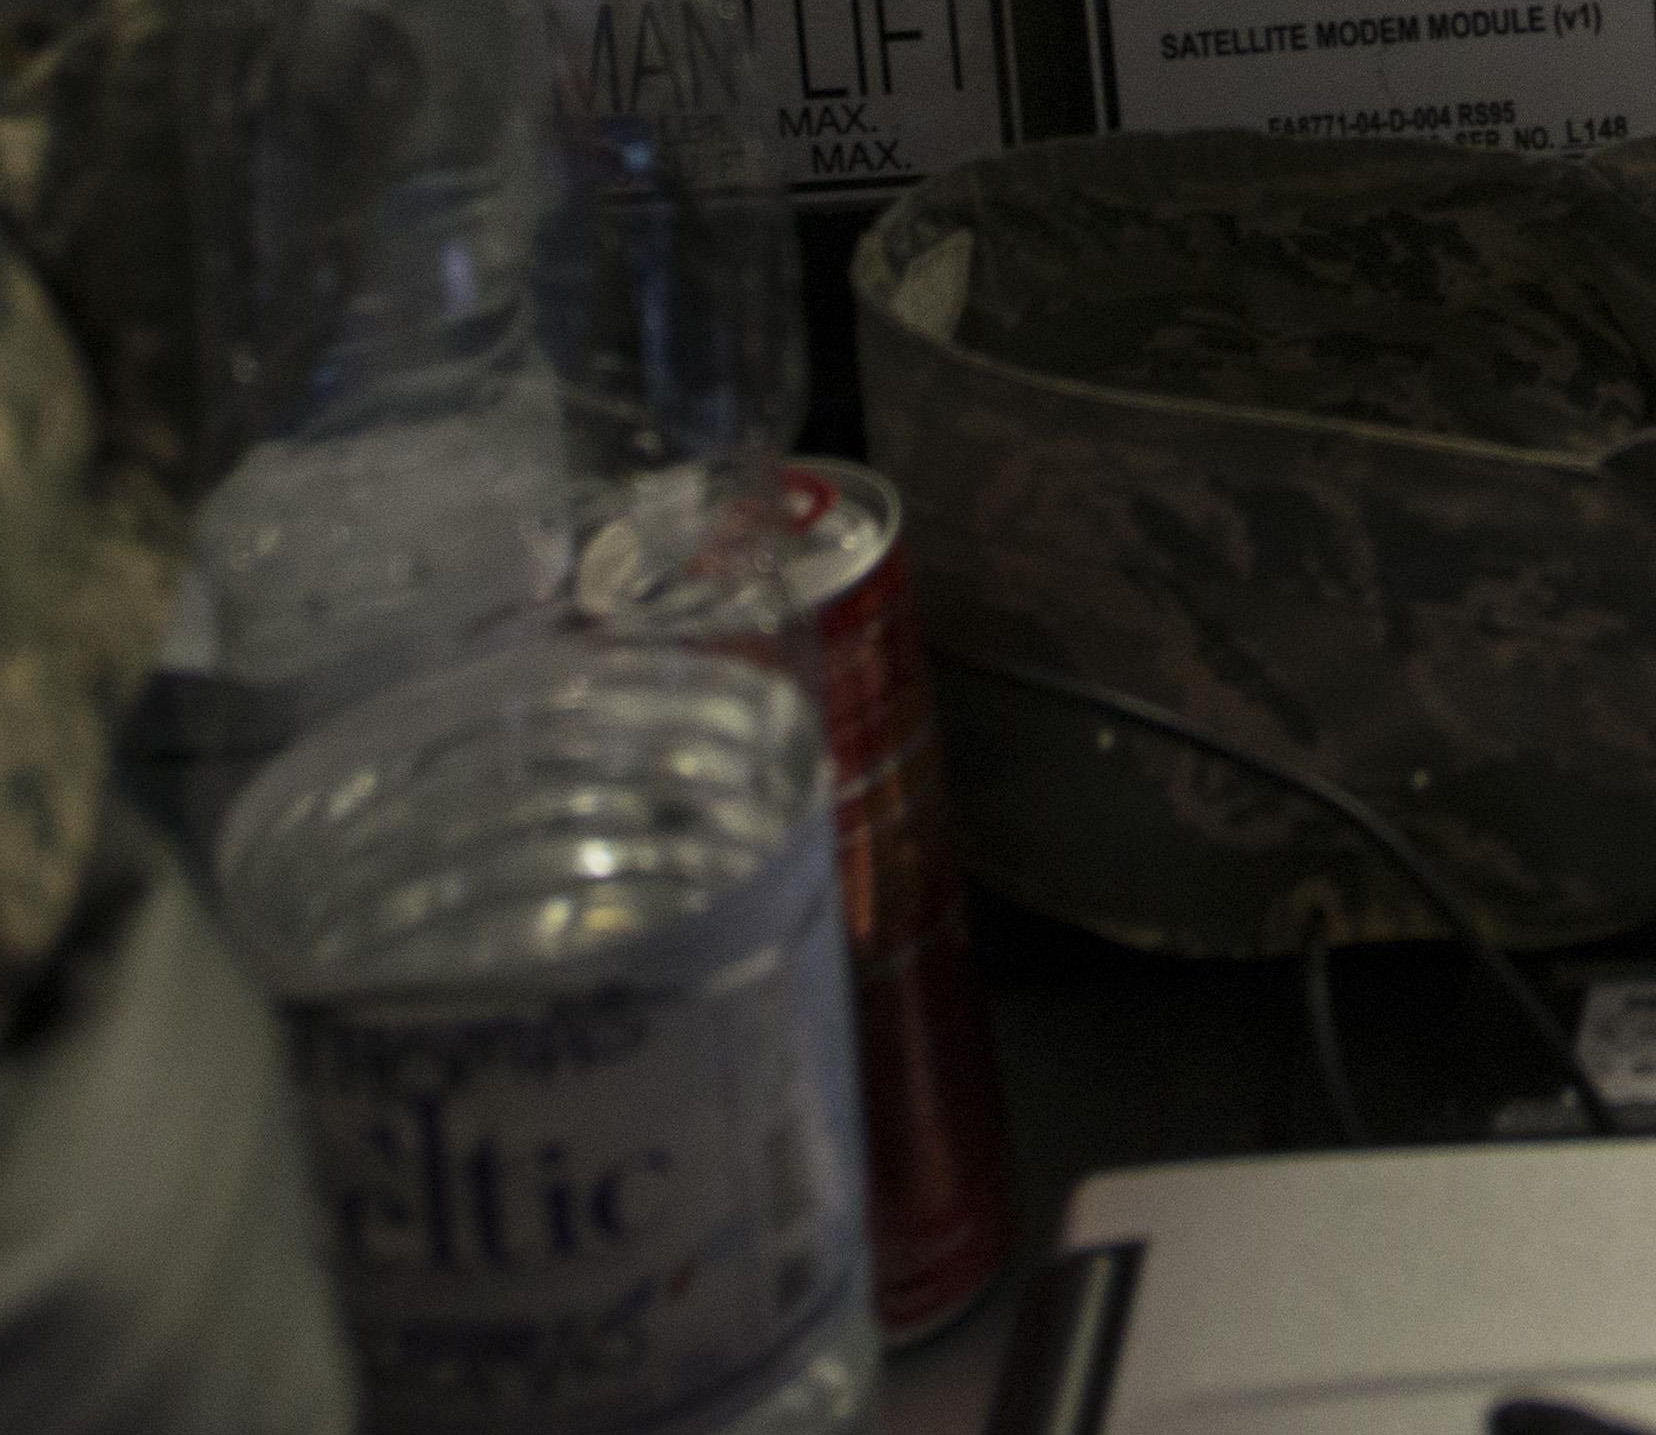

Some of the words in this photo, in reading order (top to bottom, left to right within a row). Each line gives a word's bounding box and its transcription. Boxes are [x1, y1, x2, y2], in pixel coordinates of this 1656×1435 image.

[1160, 25, 1308, 60] SATELLITE
[1317, 15, 1418, 48] MODEM
[1427, 5, 1546, 40] MODULE
[1553, 2, 1602, 38] (v1)
[779, 103, 877, 138] MAX.
[1459, 100, 1515, 127] RS95
[1565, 117, 1627, 145] L148
[812, 138, 912, 174] MAX.
